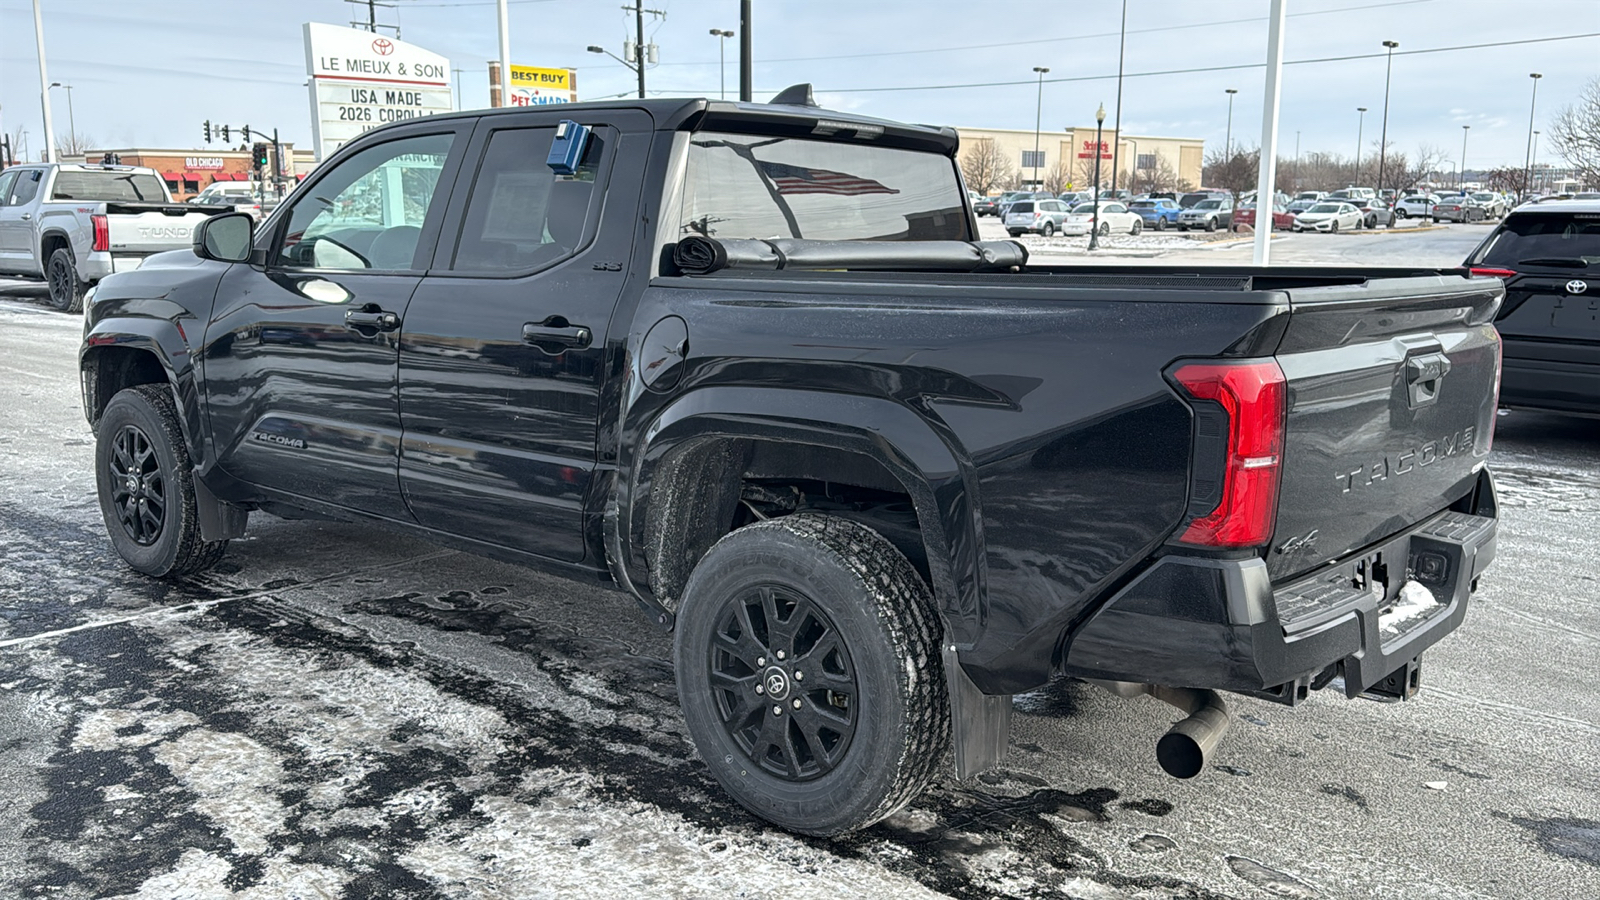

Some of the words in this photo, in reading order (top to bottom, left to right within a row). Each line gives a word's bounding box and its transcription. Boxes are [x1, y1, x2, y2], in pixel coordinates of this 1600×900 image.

[321, 57, 340, 71] LE
[346, 58, 391, 75] MIEUX
[398, 62, 407, 76] &
[414, 63, 444, 78] SON
[511, 71, 539, 82] BEST
[541, 73, 565, 84] BUY
[351, 88, 378, 104] USA
[386, 91, 422, 106] MADE
[339, 106, 372, 121] 2026
[185, 157, 198, 167] OLD
[199, 157, 224, 167] CHICAGO
[138, 227, 194, 238] TUND
[248, 431, 304, 448] TACOMA
[1335, 425, 1475, 493] TACOMA
